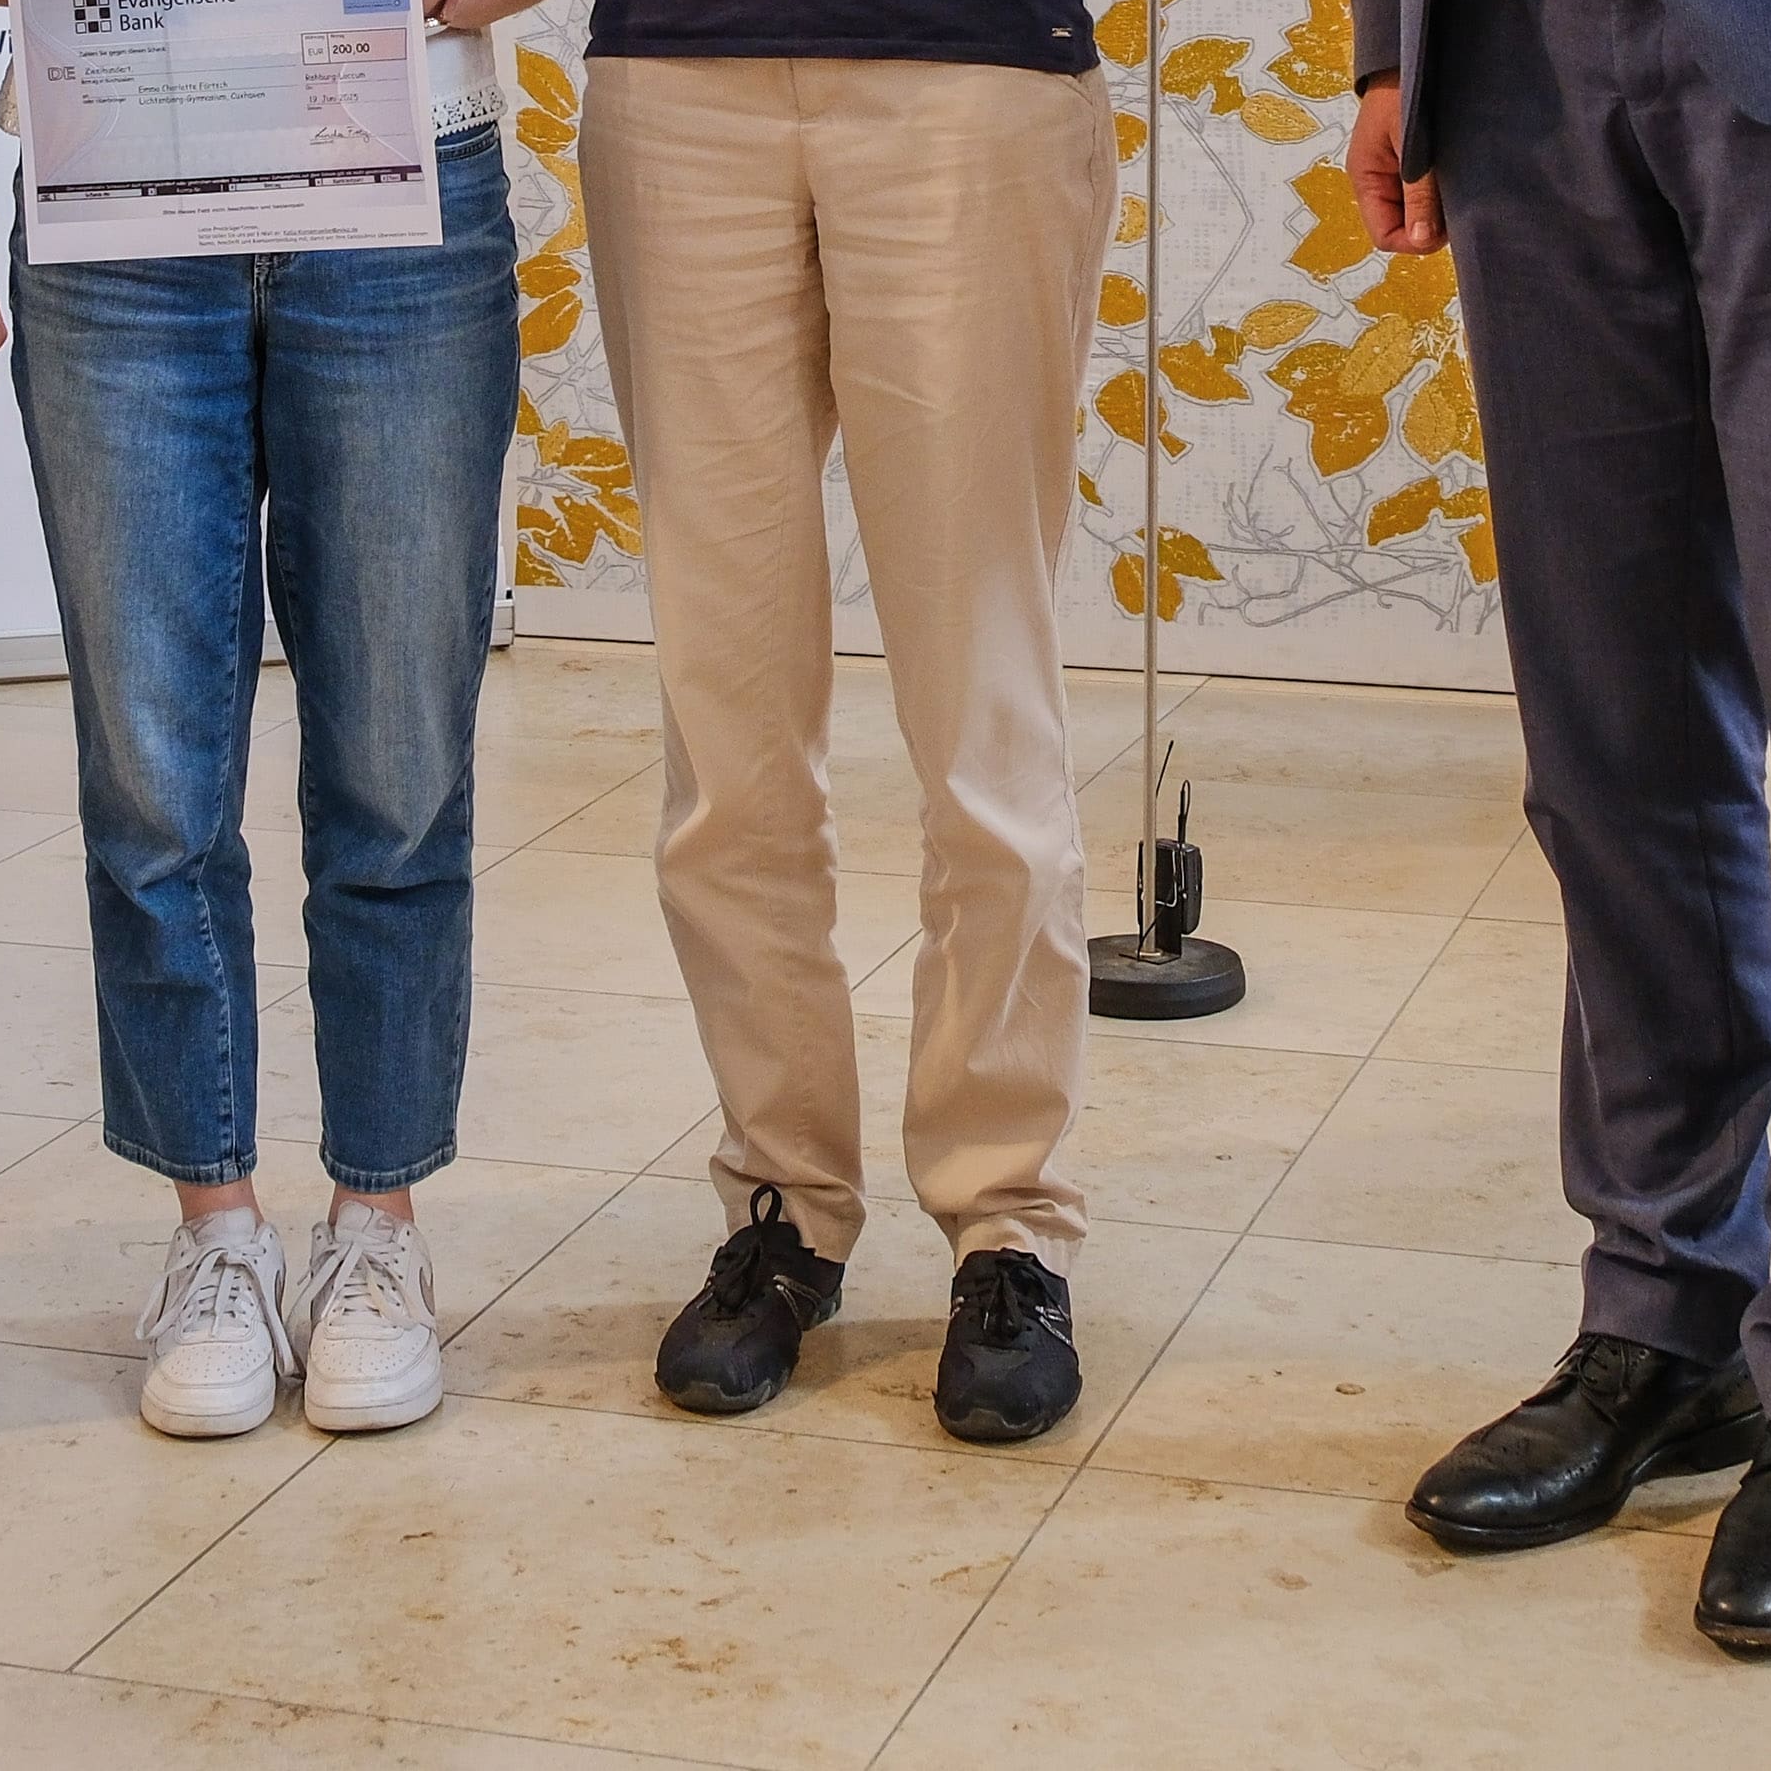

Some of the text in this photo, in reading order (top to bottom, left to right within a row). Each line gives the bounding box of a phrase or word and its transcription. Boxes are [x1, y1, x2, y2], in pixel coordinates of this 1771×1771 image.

[120, 11, 165, 32] Bank
[308, 43, 370, 56] EUR 200,00
[47, 66, 76, 81] DE
